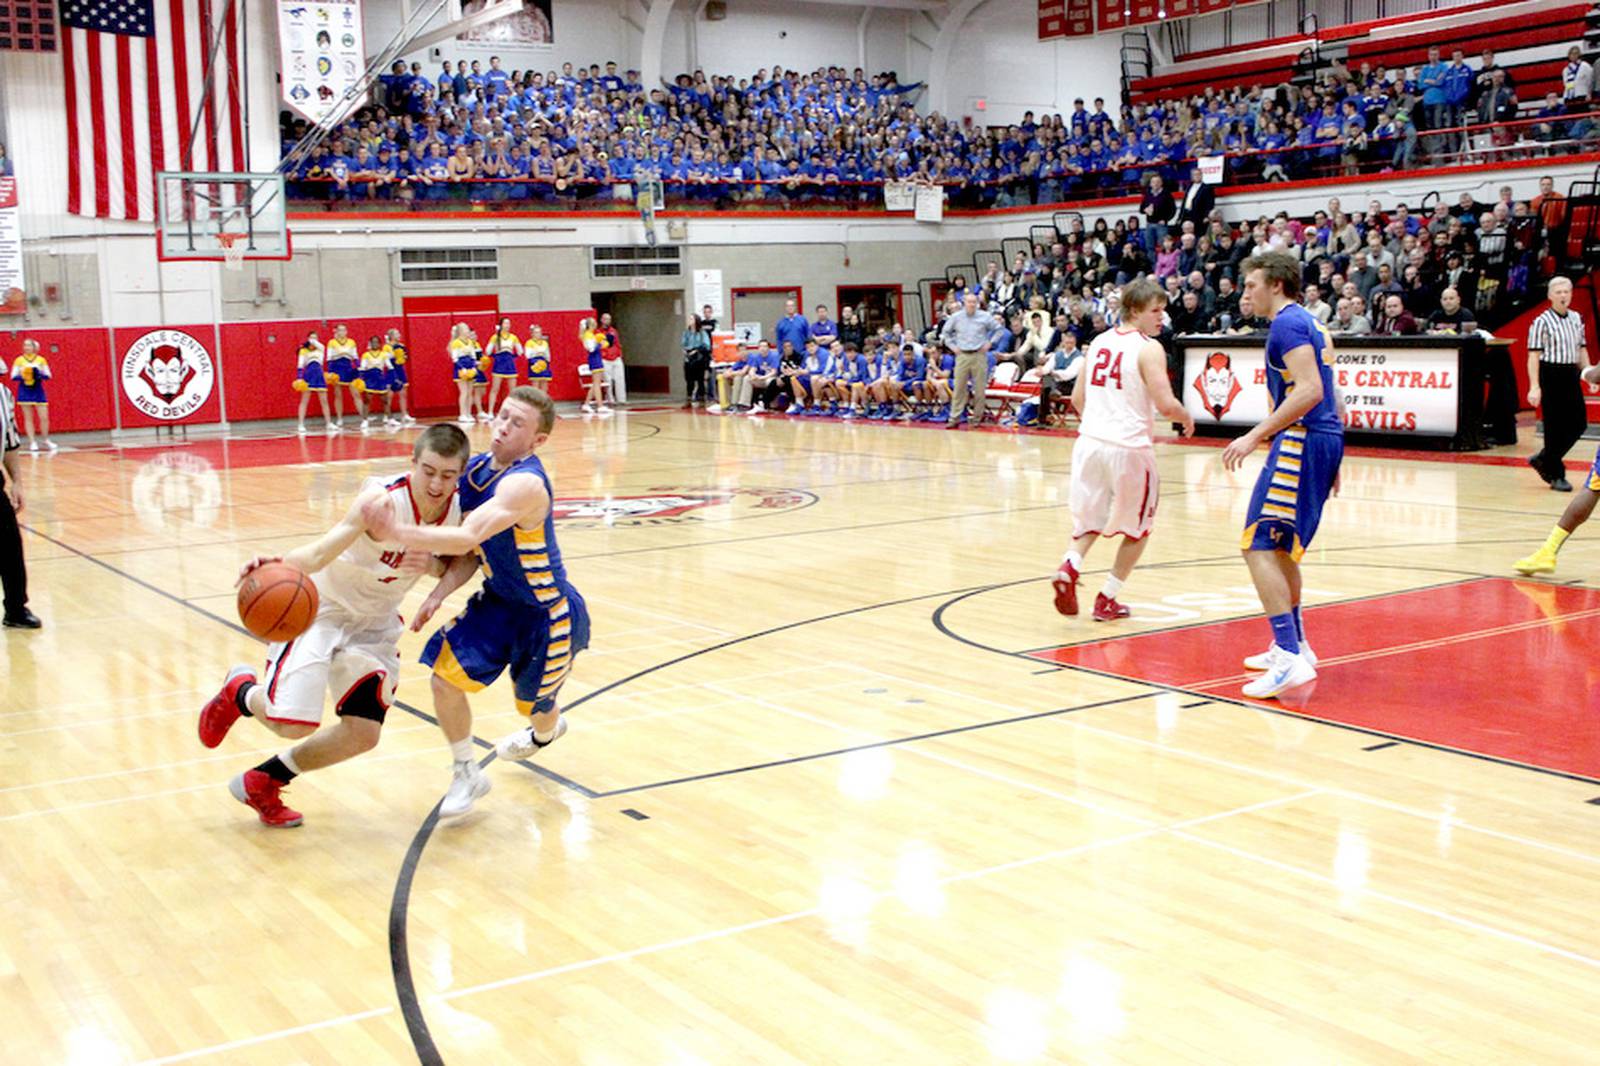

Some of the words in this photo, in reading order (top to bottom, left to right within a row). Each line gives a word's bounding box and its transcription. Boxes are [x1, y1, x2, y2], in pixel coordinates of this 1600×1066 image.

[125, 331, 167, 379] HINSDALE
[171, 332, 211, 376] CENTRAL
[1336, 354, 1368, 365] COME
[1371, 355, 1386, 365] TO
[1090, 347, 1124, 390] 24
[1355, 370, 1453, 389] CENTRAL
[135, 394, 160, 415] RED
[162, 392, 202, 417] DEVILS
[1344, 395, 1359, 405] OF
[1362, 396, 1385, 406] THE
